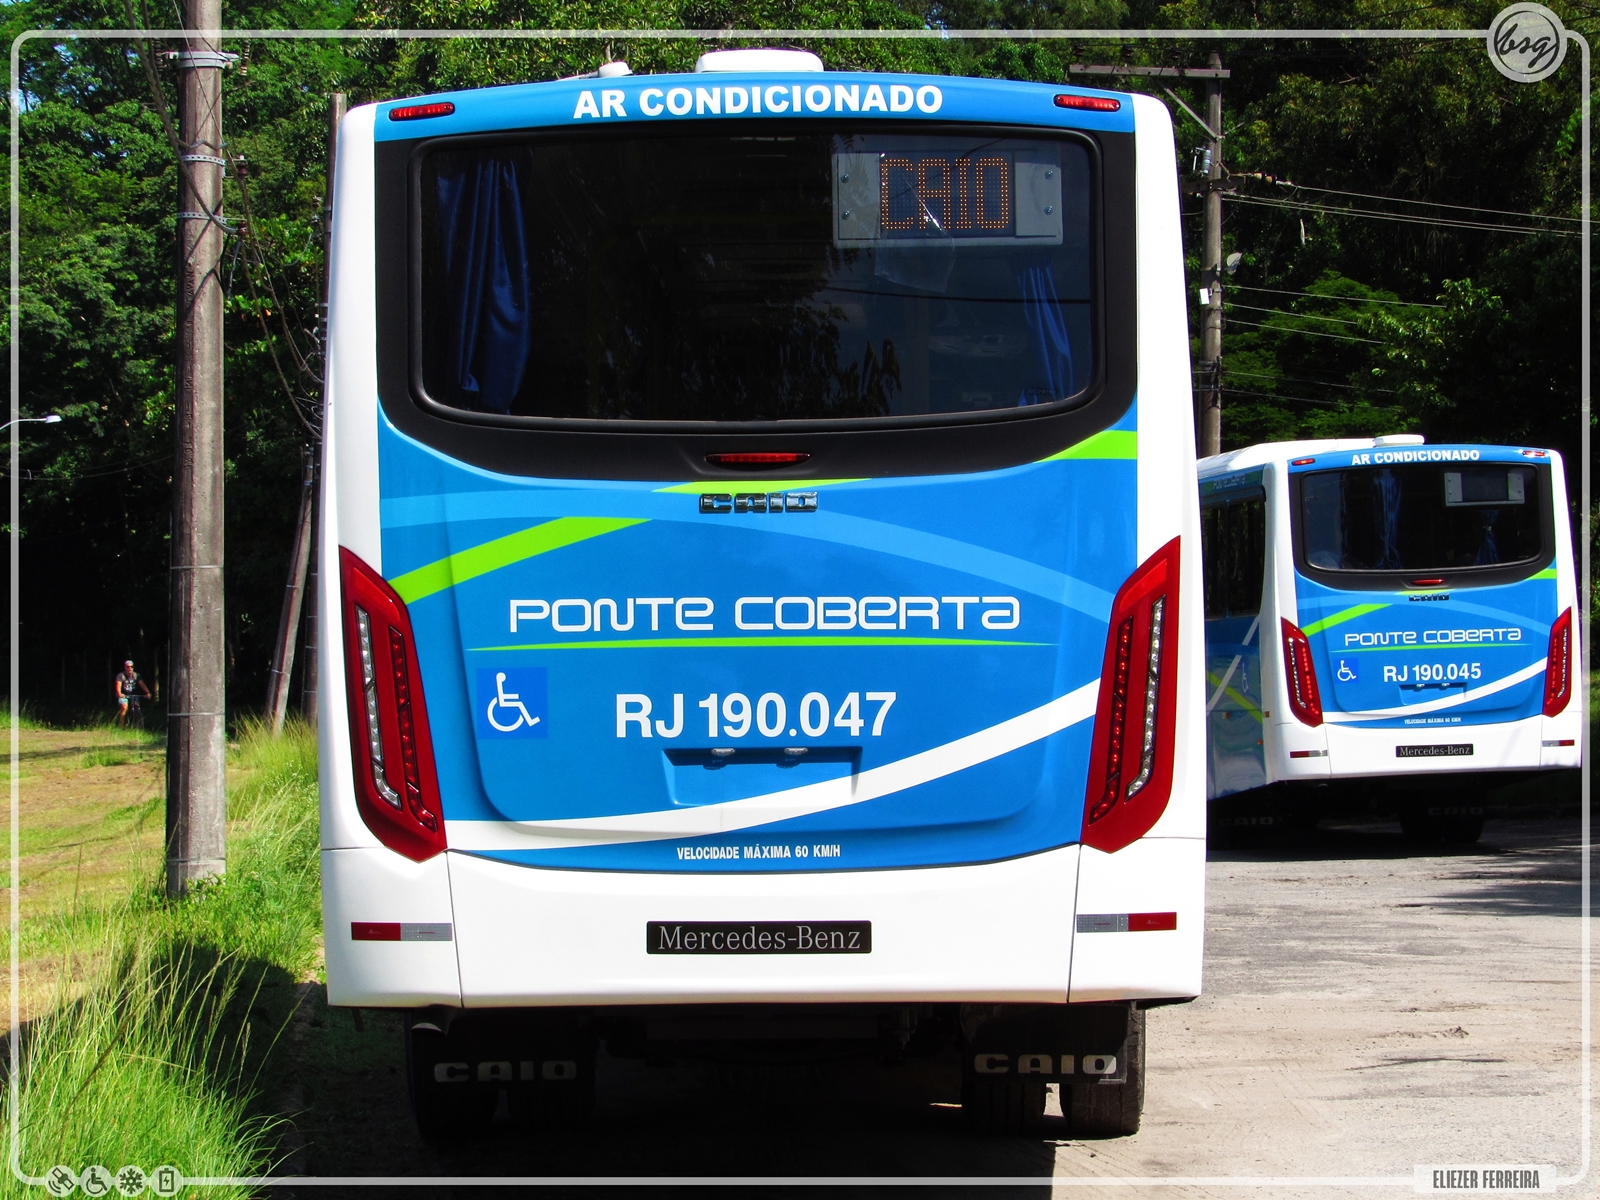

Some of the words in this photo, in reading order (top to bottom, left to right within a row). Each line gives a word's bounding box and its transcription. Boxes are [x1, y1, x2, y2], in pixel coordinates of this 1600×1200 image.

[573, 90, 627, 119] AR
[639, 85, 943, 116] CONDICIONADO
[881, 157, 1009, 230] CAIO
[1351, 454, 1371, 466] AR
[1374, 450, 1480, 464] CONDICIONADO
[1383, 665, 1408, 682] RJ
[1412, 663, 1482, 681] 190.045
[616, 693, 684, 738] RJ
[698, 691, 897, 737] 190.047
[1400, 745, 1470, 756] Mercedes-Benz
[677, 847, 740, 860] VELOCIDADE
[743, 844, 791, 859] MÁXIMA
[795, 845, 809, 858] 60
[813, 845, 841, 857] KM/H
[658, 925, 861, 950] Mercedes-Benz
[434, 1060, 577, 1082] CAIO
[974, 1053, 1117, 1074] CAIO
